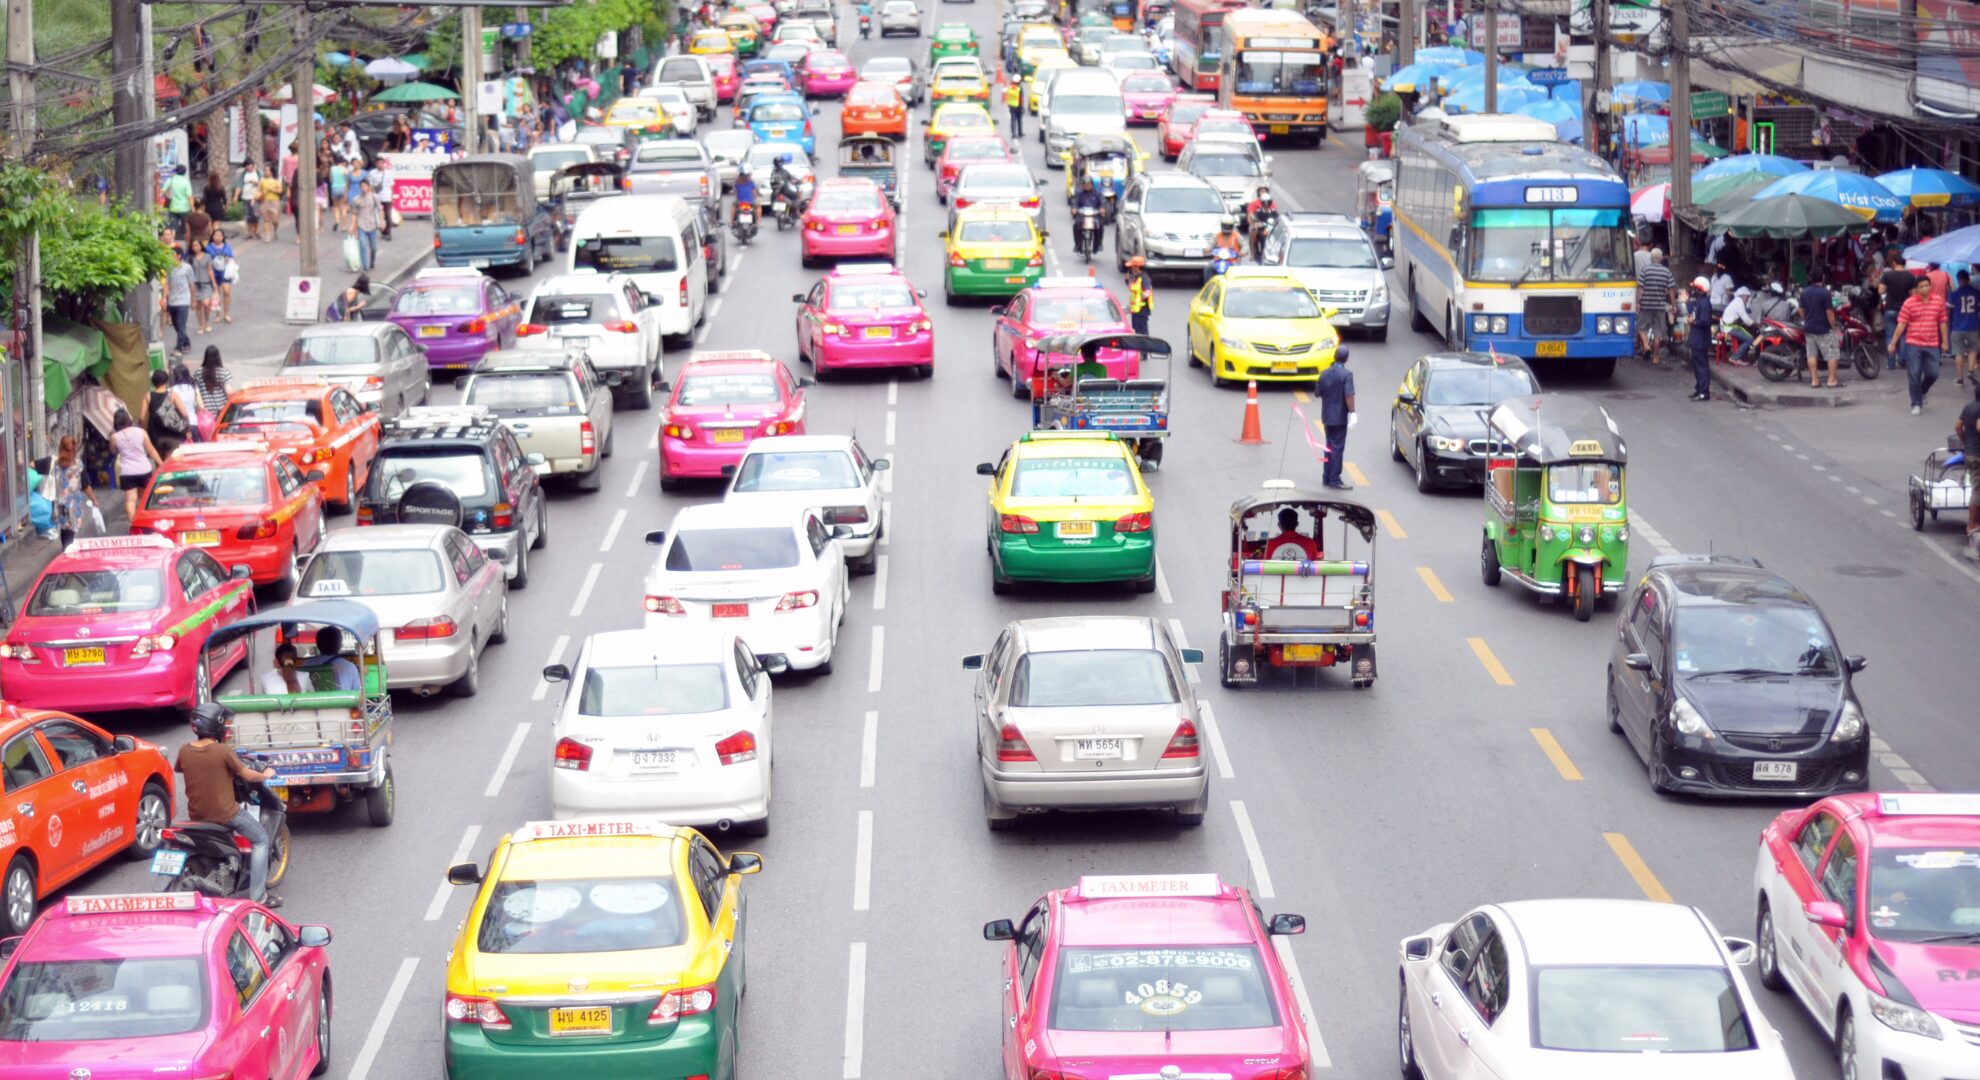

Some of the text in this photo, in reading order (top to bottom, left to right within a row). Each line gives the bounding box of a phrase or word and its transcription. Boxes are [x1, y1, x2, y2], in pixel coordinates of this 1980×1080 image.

[1541, 189, 1565, 201] 113
[1960, 295, 1975, 313] 12
[1576, 443, 1597, 452] TAXI
[404, 505, 455, 516] SPORTAGE
[318, 582, 342, 592] TAXI
[82, 649, 102, 658] 3790
[1096, 740, 1120, 750] 5654
[652, 753, 676, 763] 7332
[1774, 764, 1792, 773] 578
[549, 822, 634, 836] TAXI-METER
[83, 896, 176, 912] TAXI-METER
[1110, 955, 1251, 968] 02-878-9000
[1125, 979, 1202, 1005] 40859
[68, 1000, 128, 1012] 12418
[580, 1008, 608, 1022] 4125
